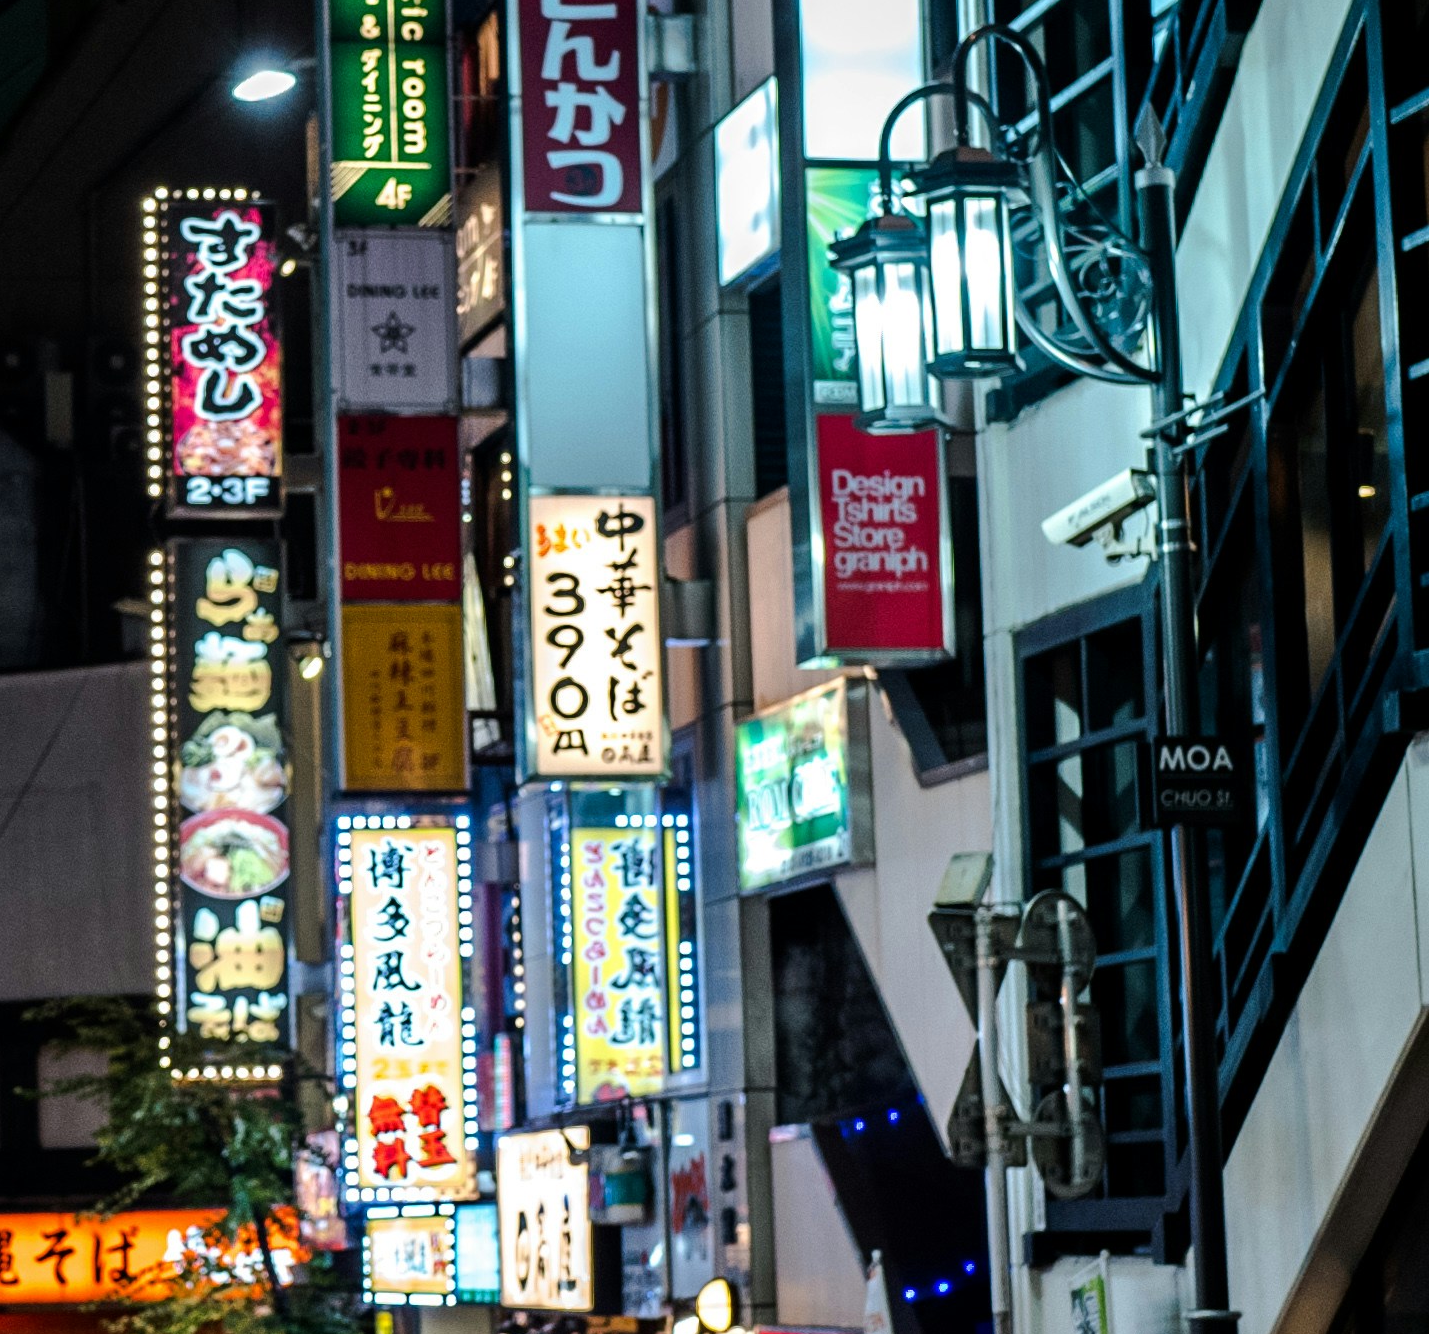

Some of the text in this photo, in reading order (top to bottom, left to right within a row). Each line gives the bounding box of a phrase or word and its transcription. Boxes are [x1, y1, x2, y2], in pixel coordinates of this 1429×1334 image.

[360, 48, 384, 158] ダイニング
[401, 58, 427, 154] room
[375, 177, 412, 210] 4F
[346, 284, 441, 300] DINING LEE
[831, 470, 926, 499] Design
[833, 520, 904, 549] Store
[833, 546, 928, 579] graniph
[594, 503, 653, 722] 中華そば
[543, 572, 589, 757] 390円
[1159, 745, 1234, 771] MOA
[1160, 788, 1212, 807] CHUO
[367, 839, 426, 1049] 博多風龍
